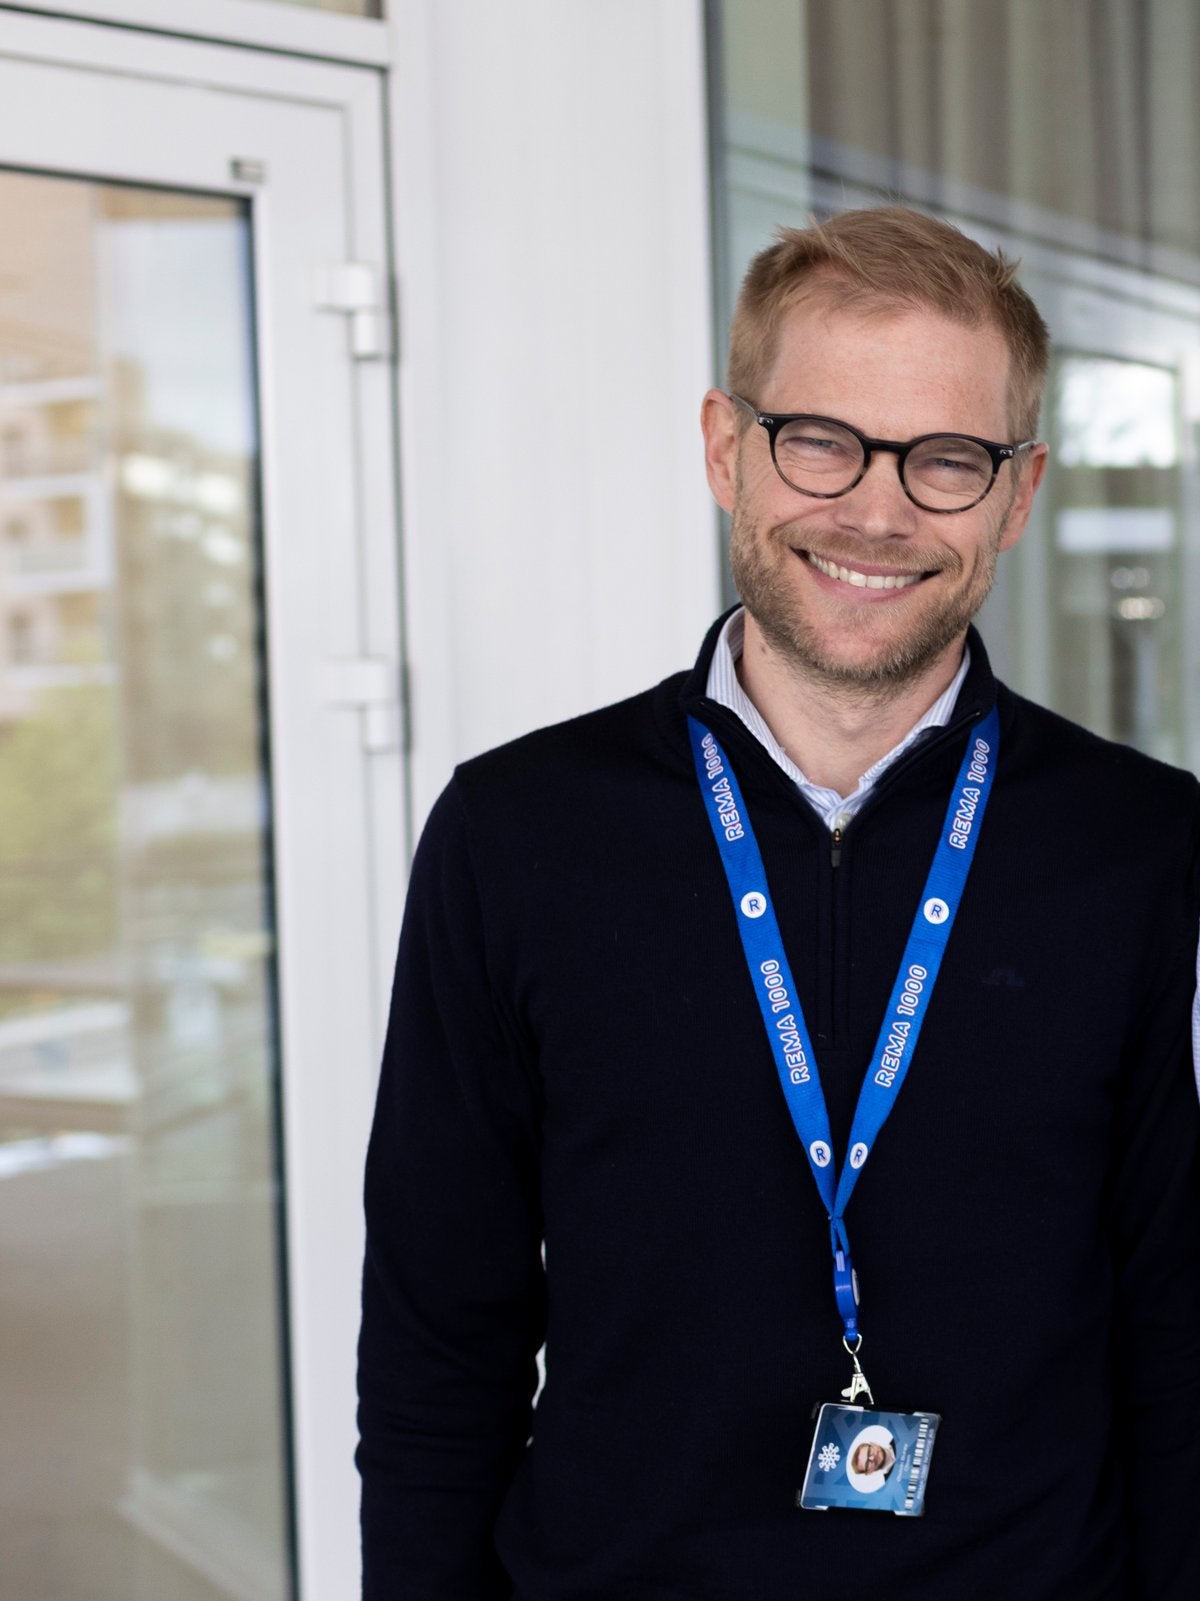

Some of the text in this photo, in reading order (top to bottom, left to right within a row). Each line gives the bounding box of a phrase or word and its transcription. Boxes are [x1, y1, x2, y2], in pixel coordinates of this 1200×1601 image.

[701, 732, 745, 842] REMA 1000
[949, 738, 991, 850] REMA 1000
[760, 959, 811, 1085] REMA 1000
[874, 964, 928, 1088] REMA 1000
